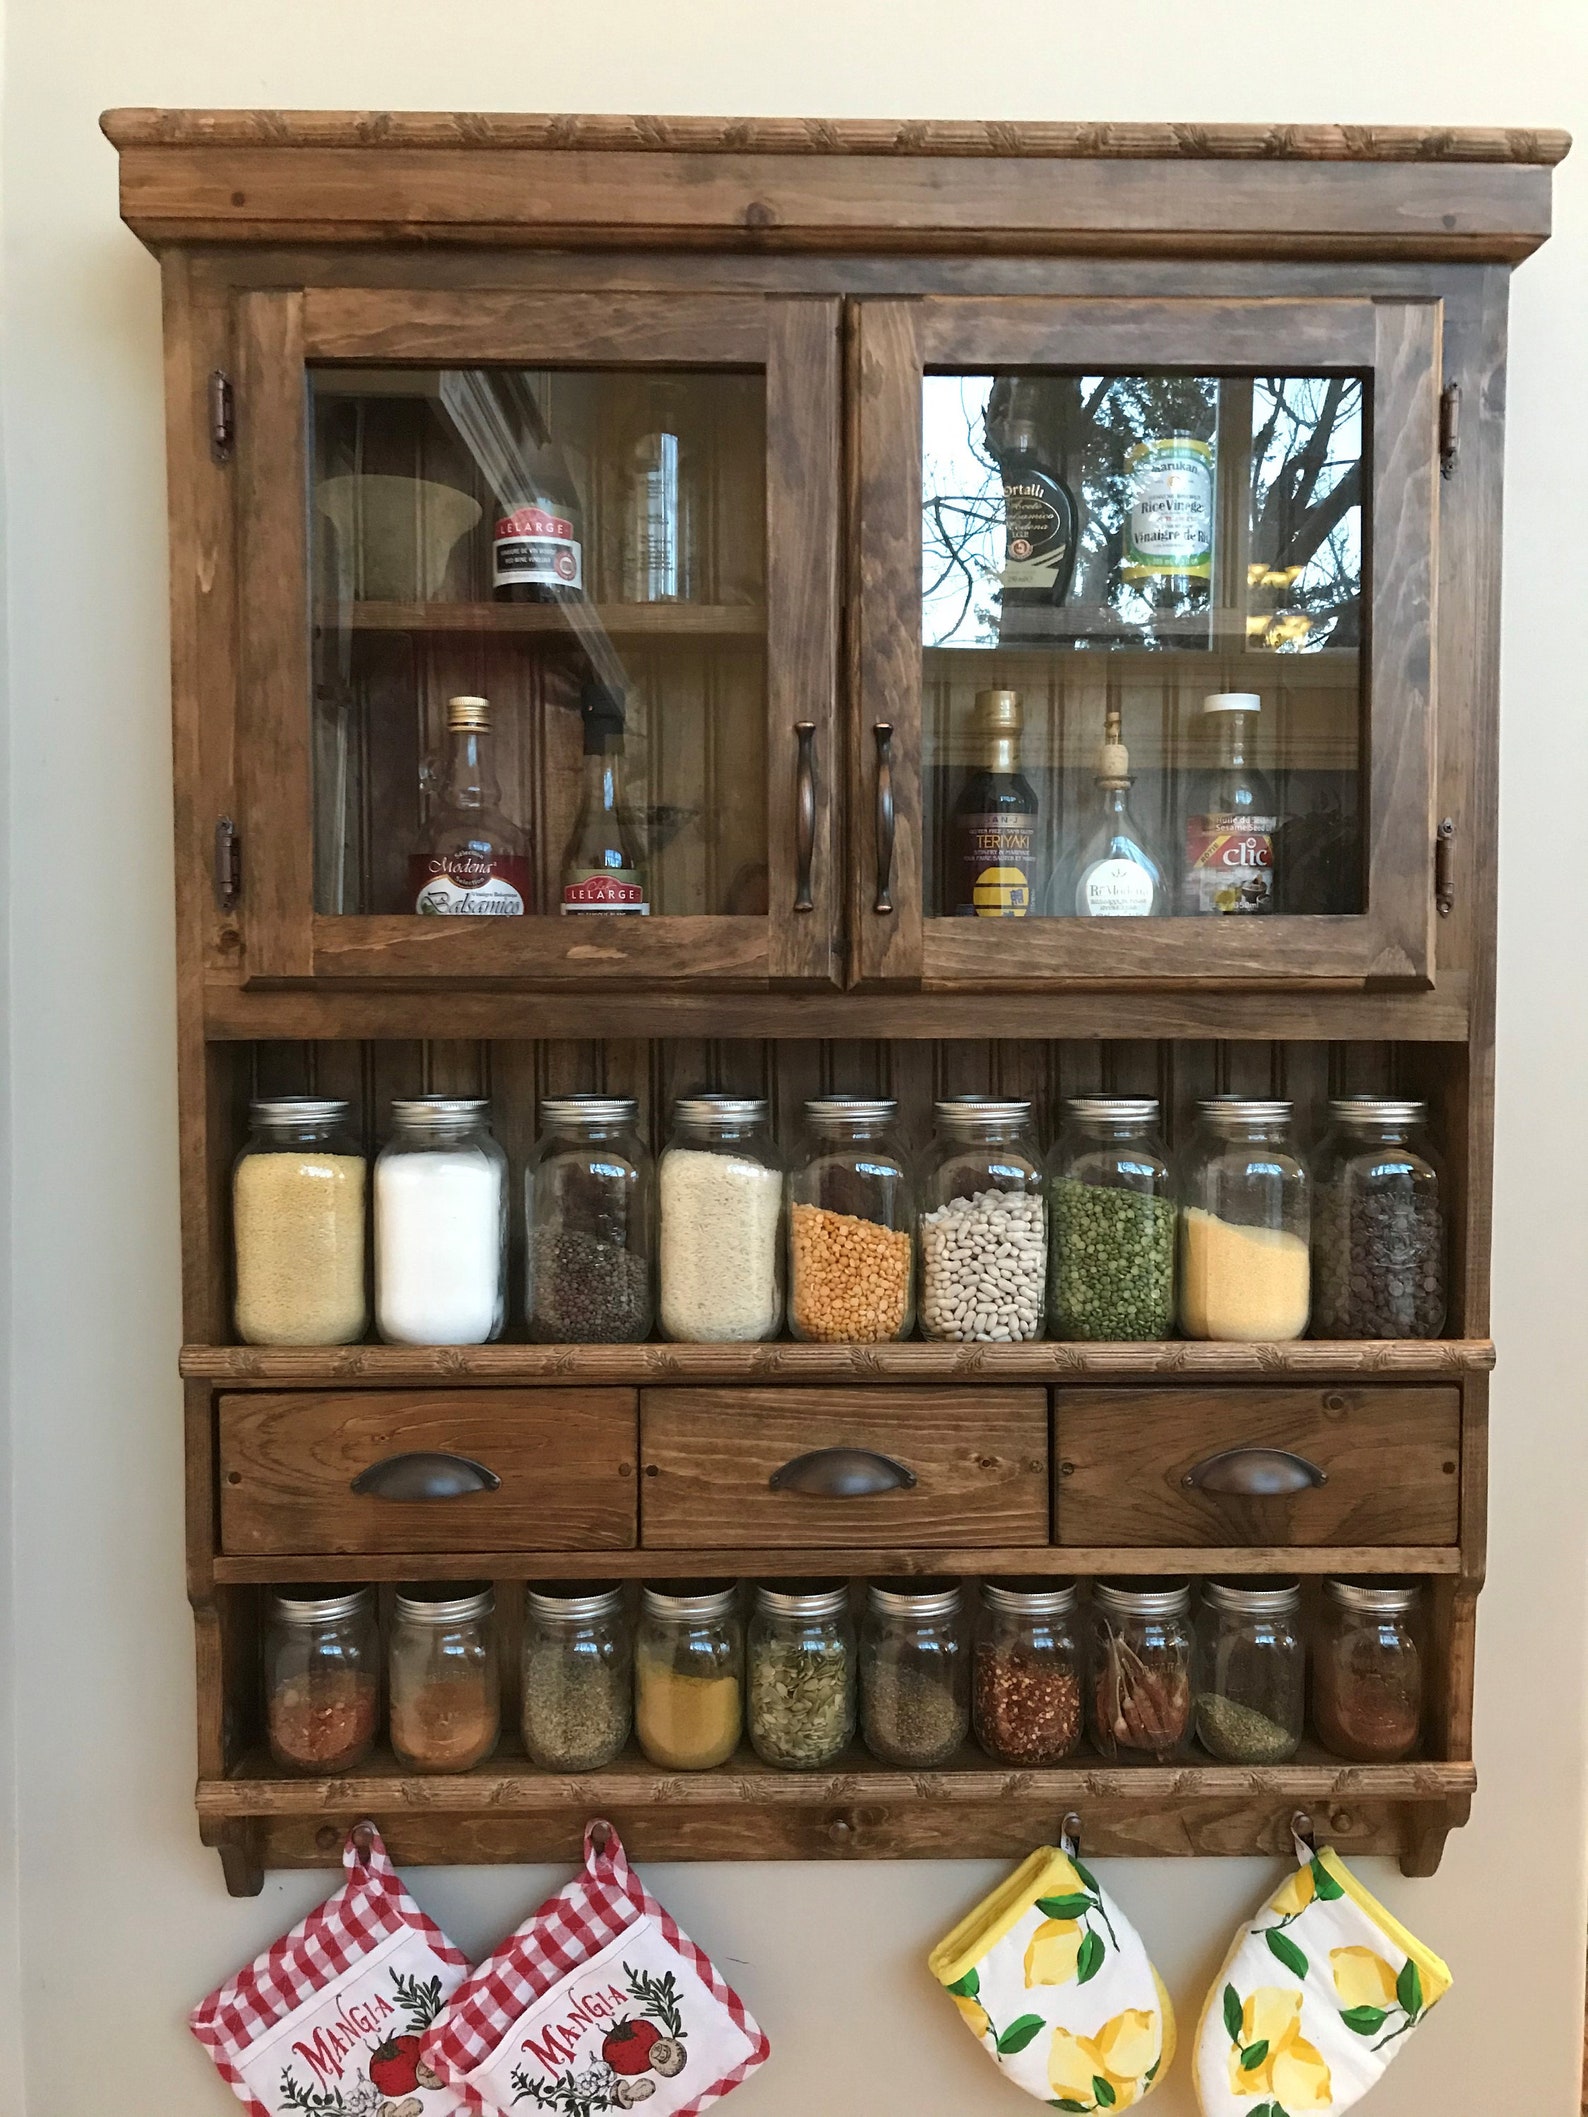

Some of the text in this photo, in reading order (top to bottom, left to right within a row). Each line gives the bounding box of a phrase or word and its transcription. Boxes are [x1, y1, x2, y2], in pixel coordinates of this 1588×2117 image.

[1141, 501, 1165, 514] Rice
[500, 522, 564, 535] LELARGE
[976, 835, 1030, 849] TERIYAKI
[1222, 837, 1268, 867] clic
[571, 889, 635, 900] LELARGE
[521, 1984, 629, 2080] MANGIA
[291, 1993, 396, 2094] MANGIA
